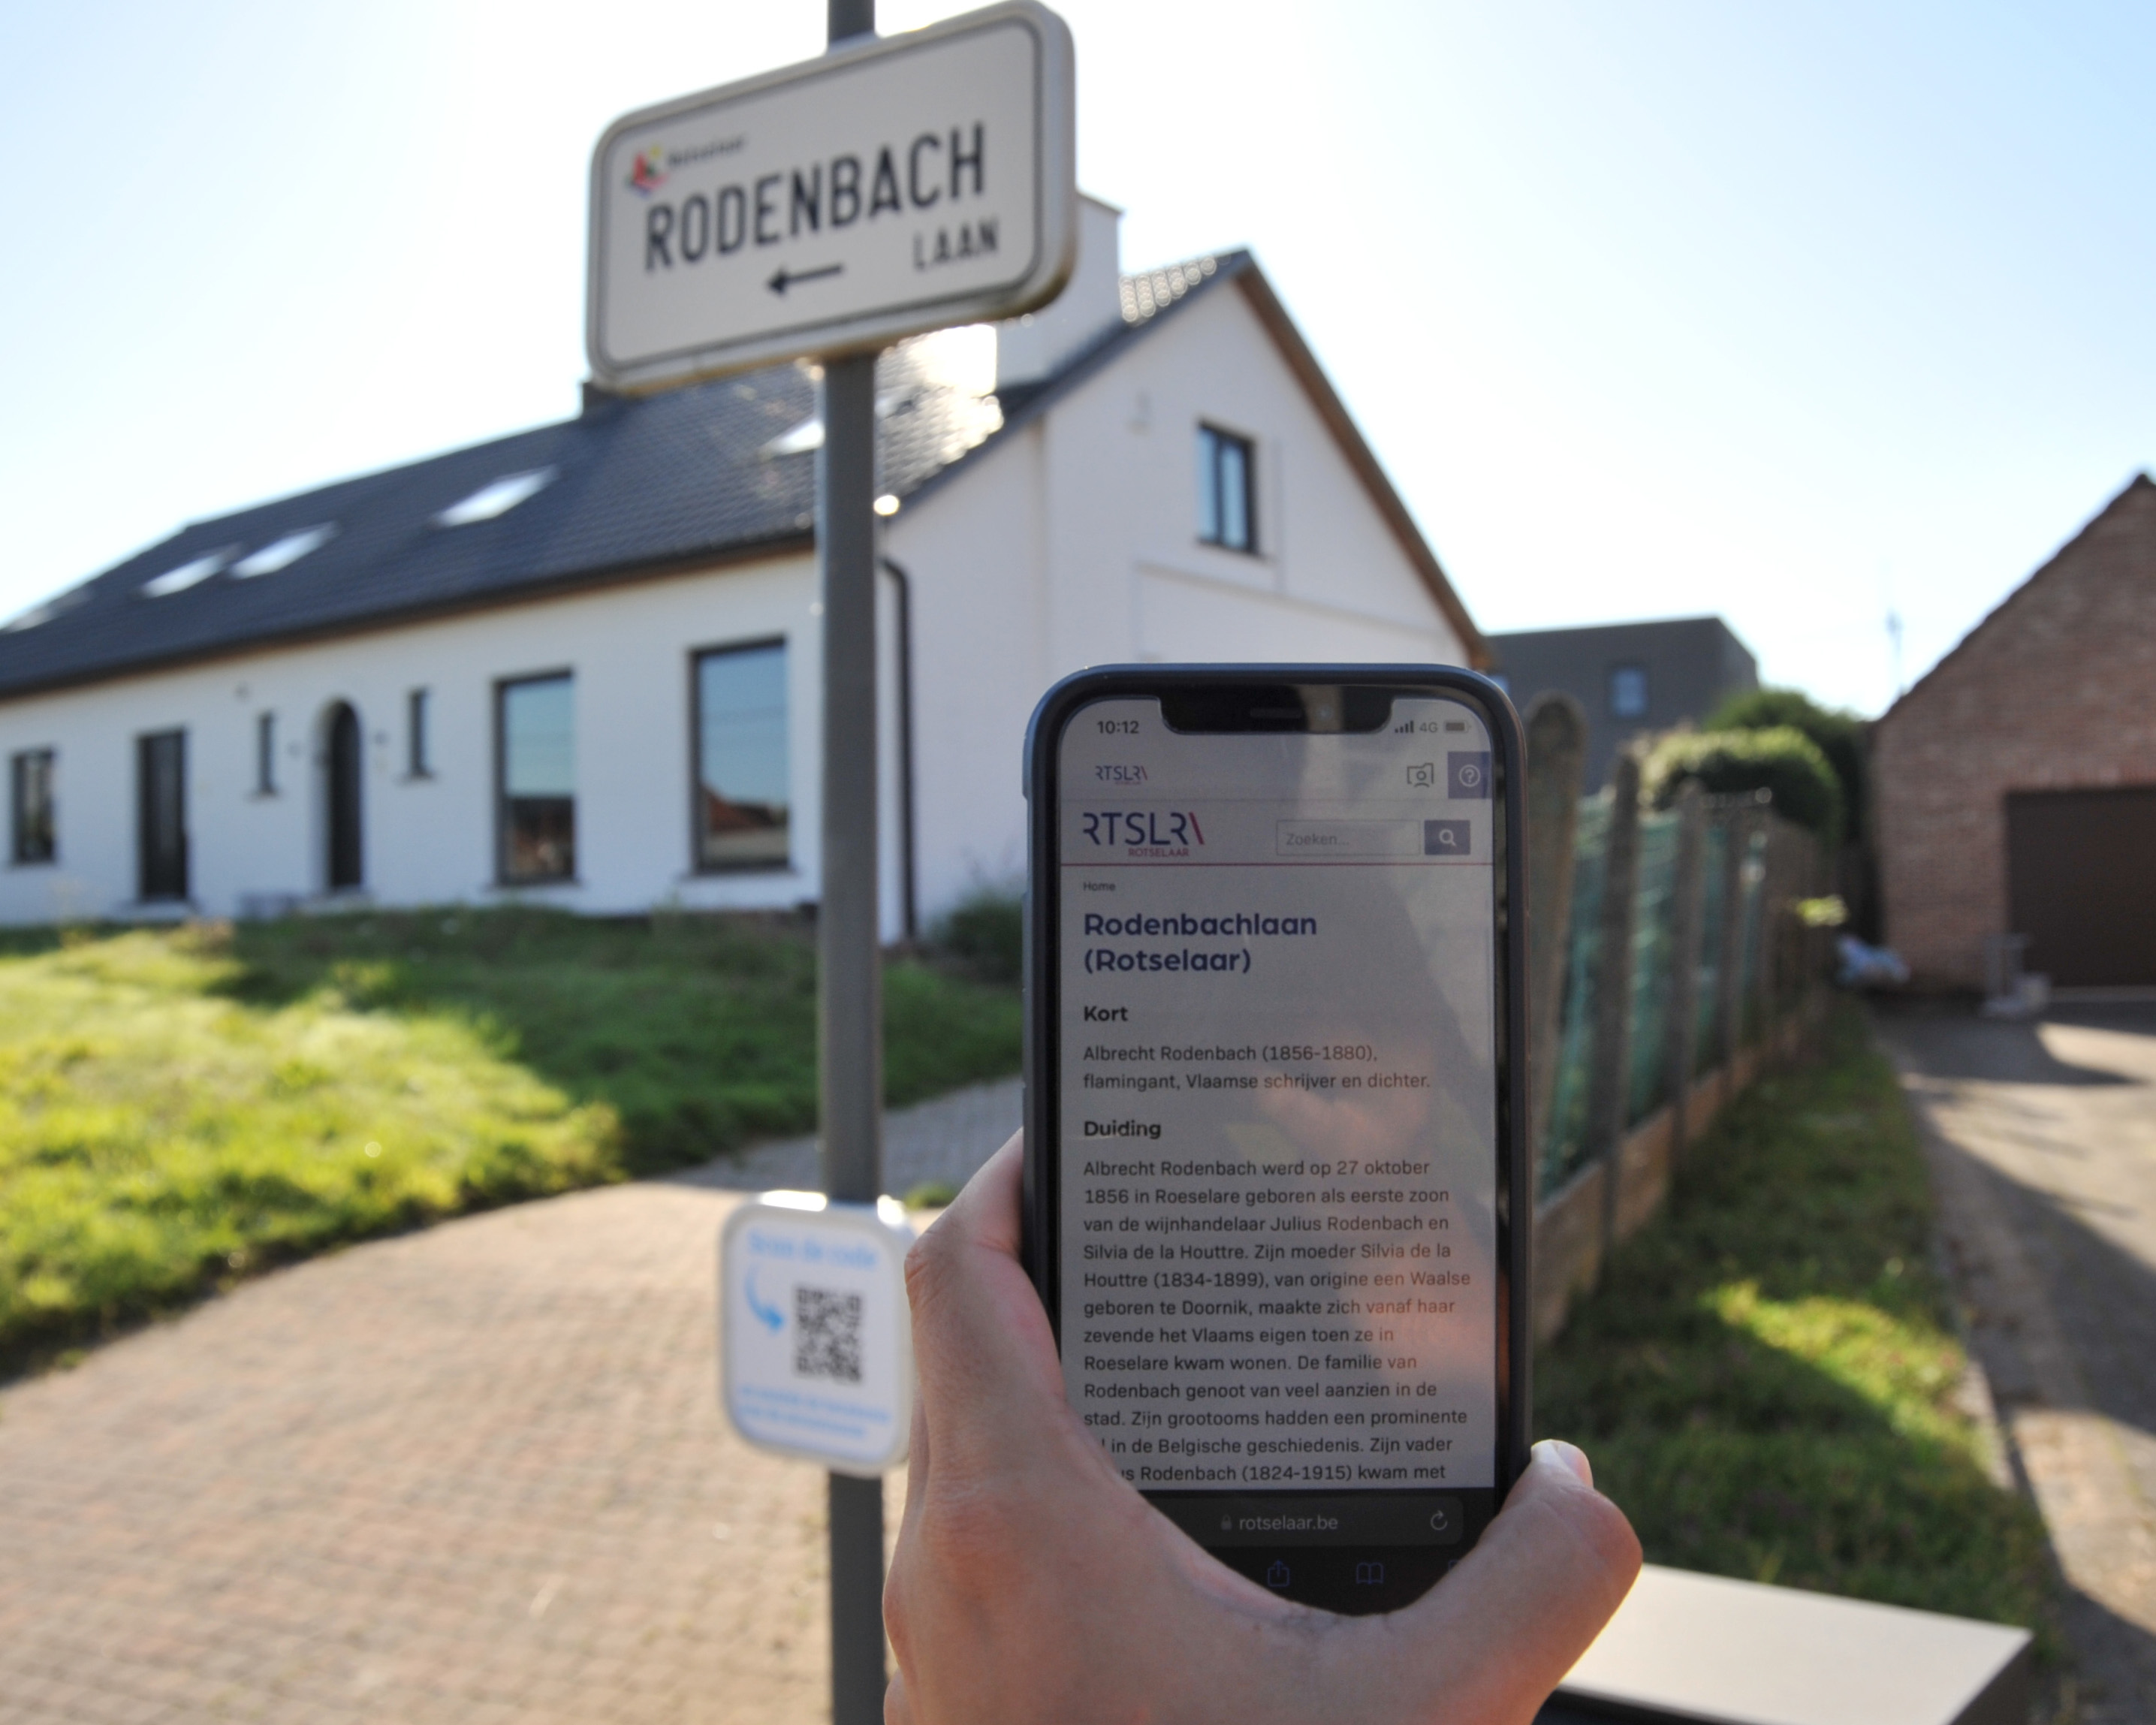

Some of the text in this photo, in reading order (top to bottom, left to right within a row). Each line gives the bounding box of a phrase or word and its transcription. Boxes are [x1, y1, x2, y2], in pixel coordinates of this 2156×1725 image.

[644, 119, 985, 272] RODENBACH
[913, 217, 1000, 271] LAAN
[1097, 719, 1140, 735] 10:12
[1419, 720, 1438, 733] 4G
[1128, 848, 1190, 858] ROTSELAAR
[1084, 881, 1116, 891] Home
[1084, 912, 1317, 936] Rodenbachlaan
[1084, 948, 1252, 974] (Rotselaar)
[1084, 1005, 1129, 1022] Kort
[1084, 1045, 1377, 1063] Albrecht Rodenbach (1856-1880),
[1083, 1072, 1430, 1092] flamingant, Vlaamse schrijver en dichter.
[1084, 1119, 1162, 1138] Duiding
[1084, 1160, 1430, 1178] Albrecht Rodenbach werd op 27 oktober
[1085, 1188, 1449, 1208] 1856 in Roeselare geboren als eerste zoon
[1084, 1215, 1449, 1235] van de wijnhandelaar Julius Rodenbach en
[1084, 1243, 1450, 1262] Silvia de la Houttre. Zijn moeder Silvia de la
[1084, 1271, 1470, 1289] Houttre (1834-1899), van origine een Waalse
[1084, 1298, 1455, 1319] geboren te Doornik, maakte zich vanaf haar
[1084, 1327, 1393, 1346] zevende het Vlaams eigen toen ze in
[1084, 1353, 1416, 1371] Roeselare kwam wonen. De familie van
[1084, 1381, 1437, 1401] Rodenbach genoot van veel aanzien in de
[1084, 1410, 1467, 1429] stad. Zijn grootooms hadden een prominente
[1111, 1439, 1126, 1453] in
[1132, 1438, 1153, 1453] de
[1159, 1438, 1241, 1457] Belgische
[1247, 1437, 1364, 1456] geschiedenis.
[1370, 1437, 1400, 1455] Zijn
[1406, 1437, 1452, 1452] vader
[1141, 1465, 1237, 1481] Rodenbach
[1241, 1465, 1352, 1482] (1824-1915)
[1358, 1464, 1407, 1479] kwam
[1413, 1465, 1446, 1479] met
[1239, 1515, 1338, 1530] rotselaar.be
